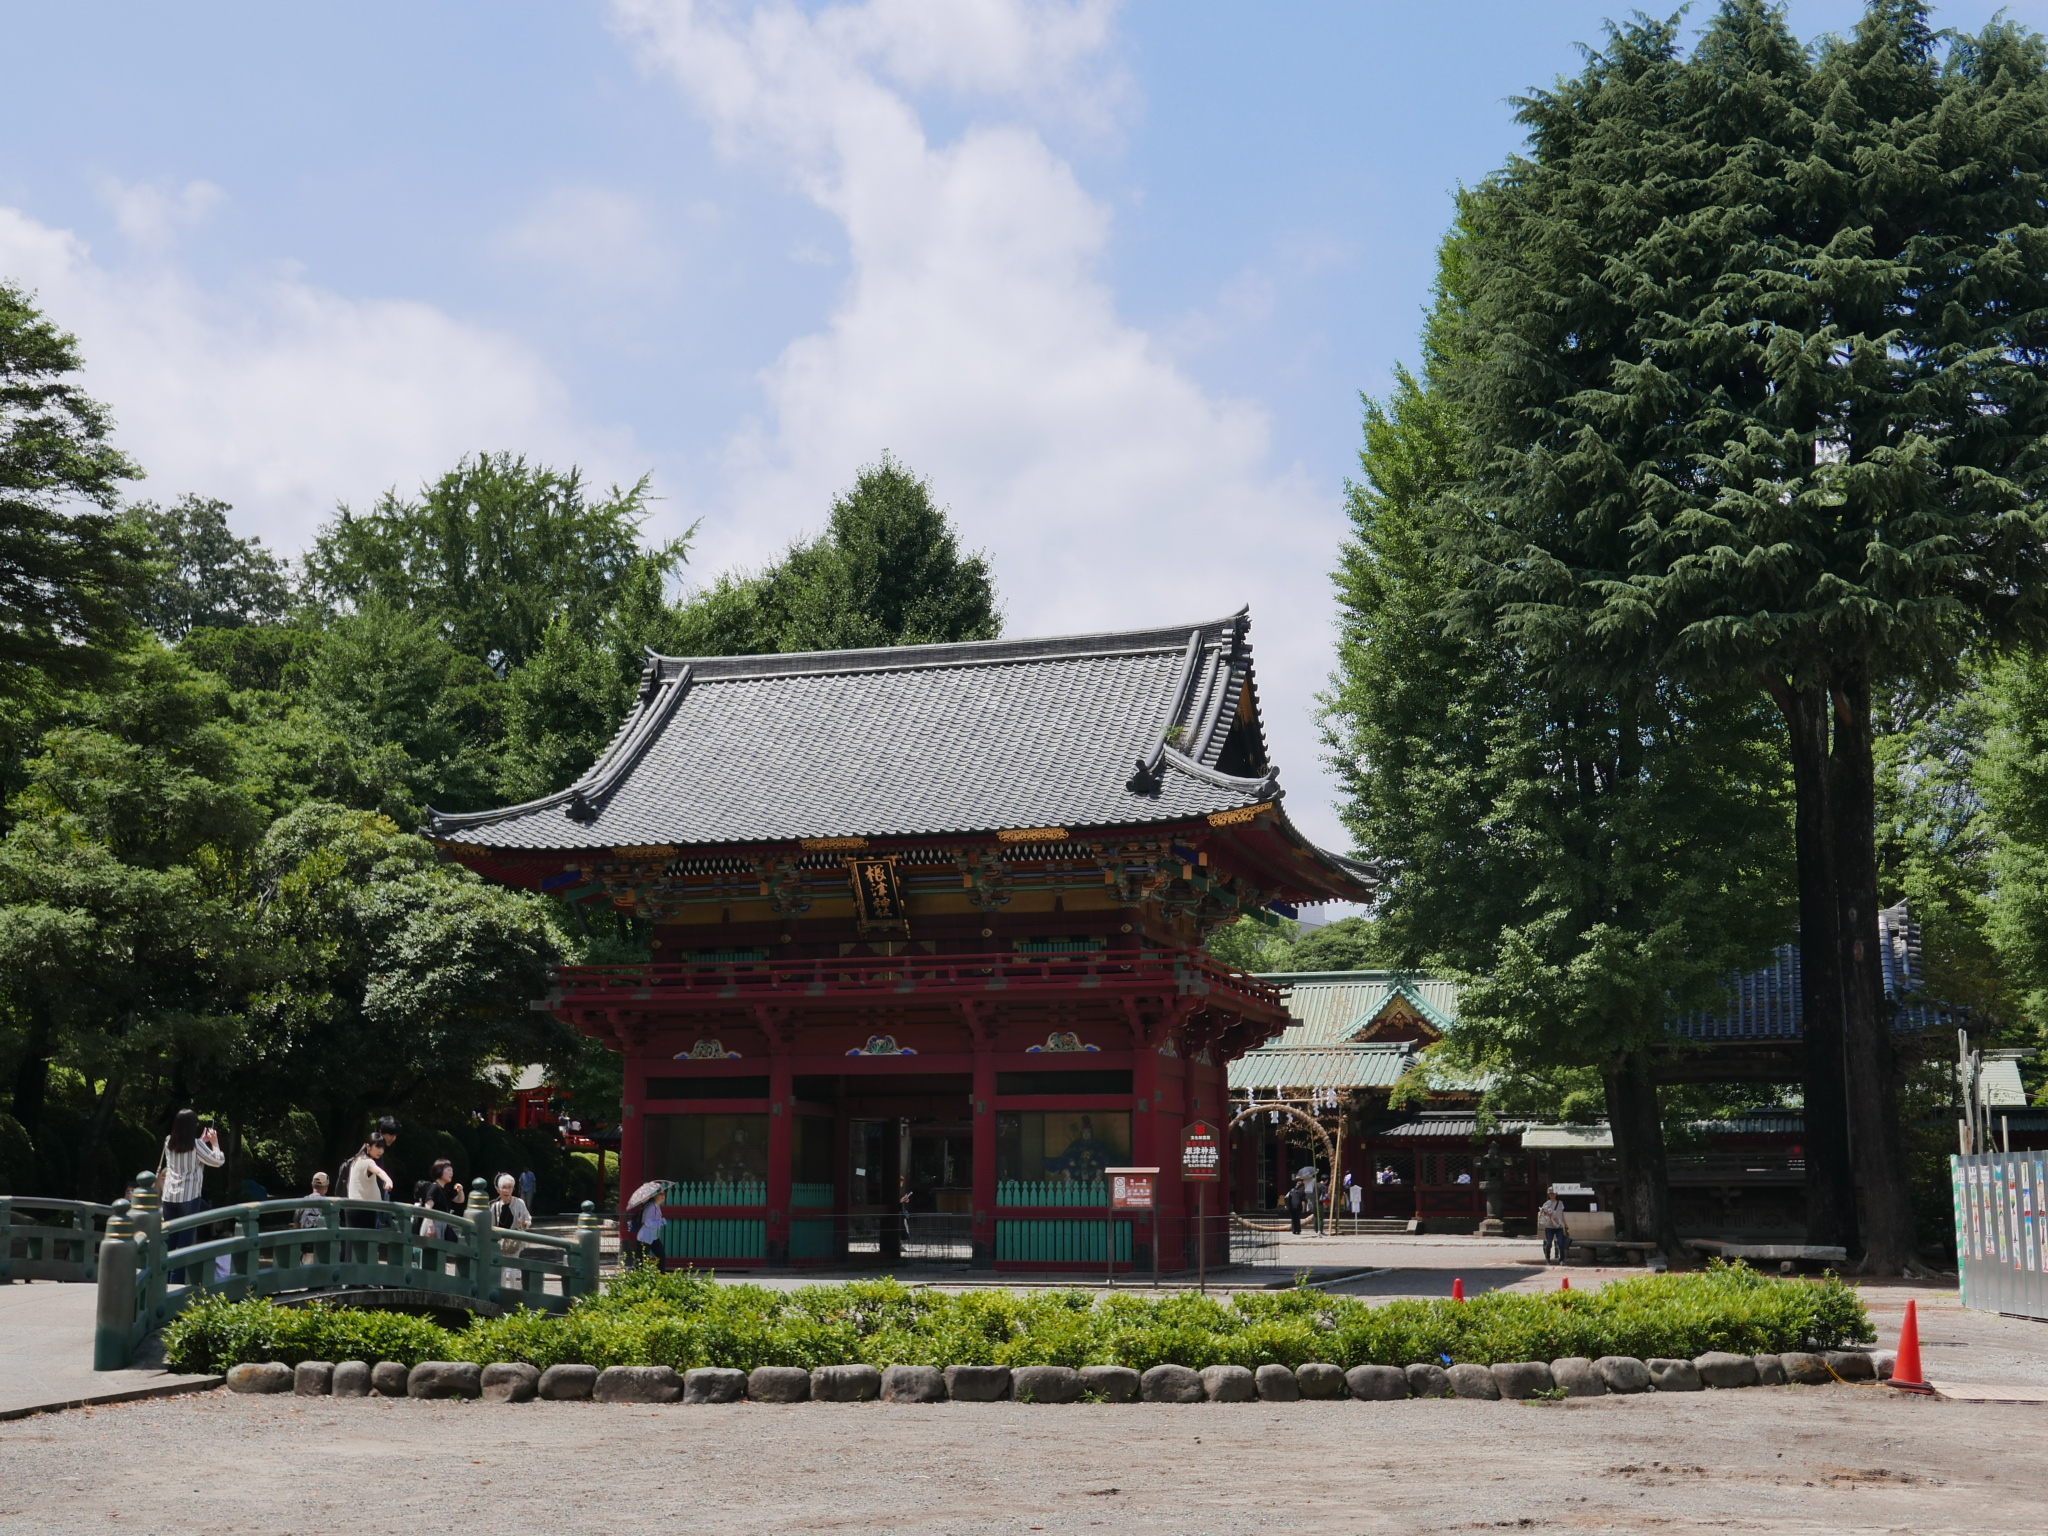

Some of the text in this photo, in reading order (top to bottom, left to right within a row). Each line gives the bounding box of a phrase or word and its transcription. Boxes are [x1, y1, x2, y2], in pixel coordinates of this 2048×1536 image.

[865, 864, 893, 918] 根津神社
[1185, 1146, 1217, 1155] 根津神社
